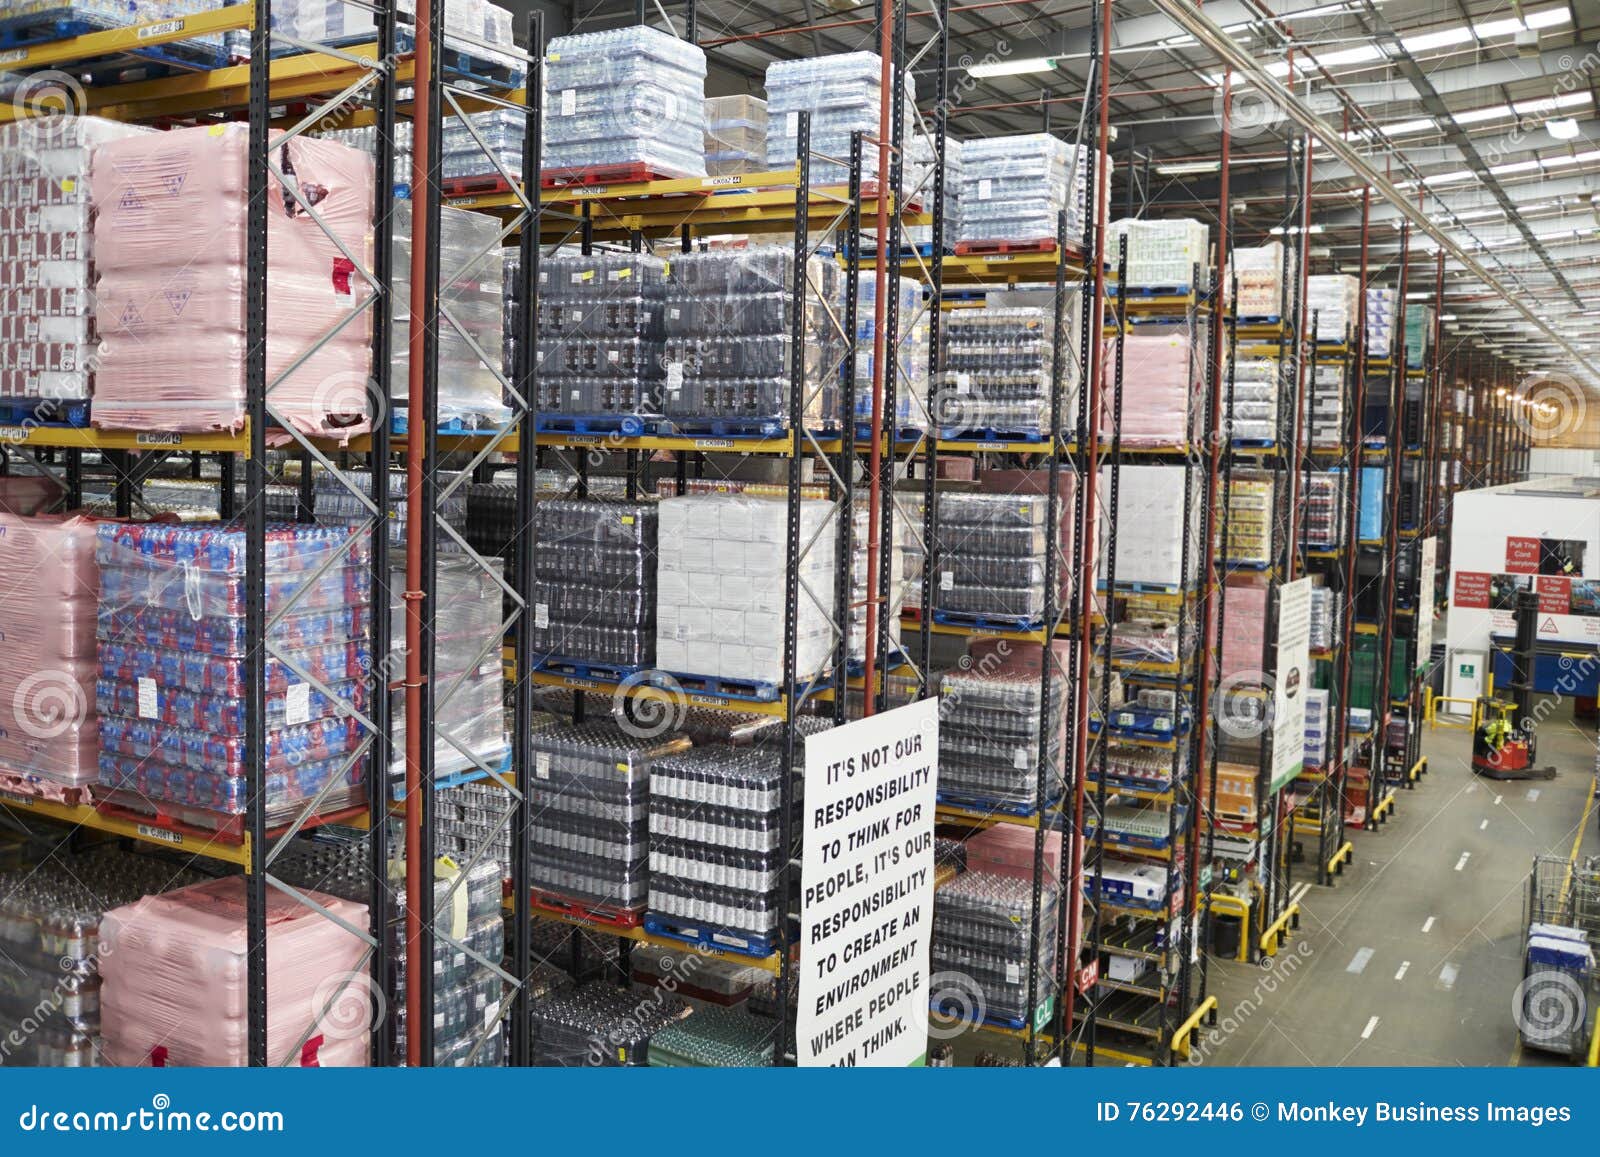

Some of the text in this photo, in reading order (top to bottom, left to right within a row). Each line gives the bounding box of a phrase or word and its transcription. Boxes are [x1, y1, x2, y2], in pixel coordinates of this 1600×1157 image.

[827, 734, 922, 785] IT'S NOT OUR
[815, 766, 930, 829] RESPONSIBILITY
[822, 804, 921, 863] TO THINK FOR
[806, 831, 931, 909] PEOPLE, IT'S OUR
[811, 867, 926, 945] RESPONSIBILITY
[817, 905, 920, 979] TO CREATE AN
[1081, 960, 1097, 984] CM
[816, 939, 917, 1016] ENVIRONMENT
[811, 971, 920, 1057] WHERE PEOPLE
[829, 1017, 907, 1067] AN THINK.
[1036, 999, 1051, 1024] CL
